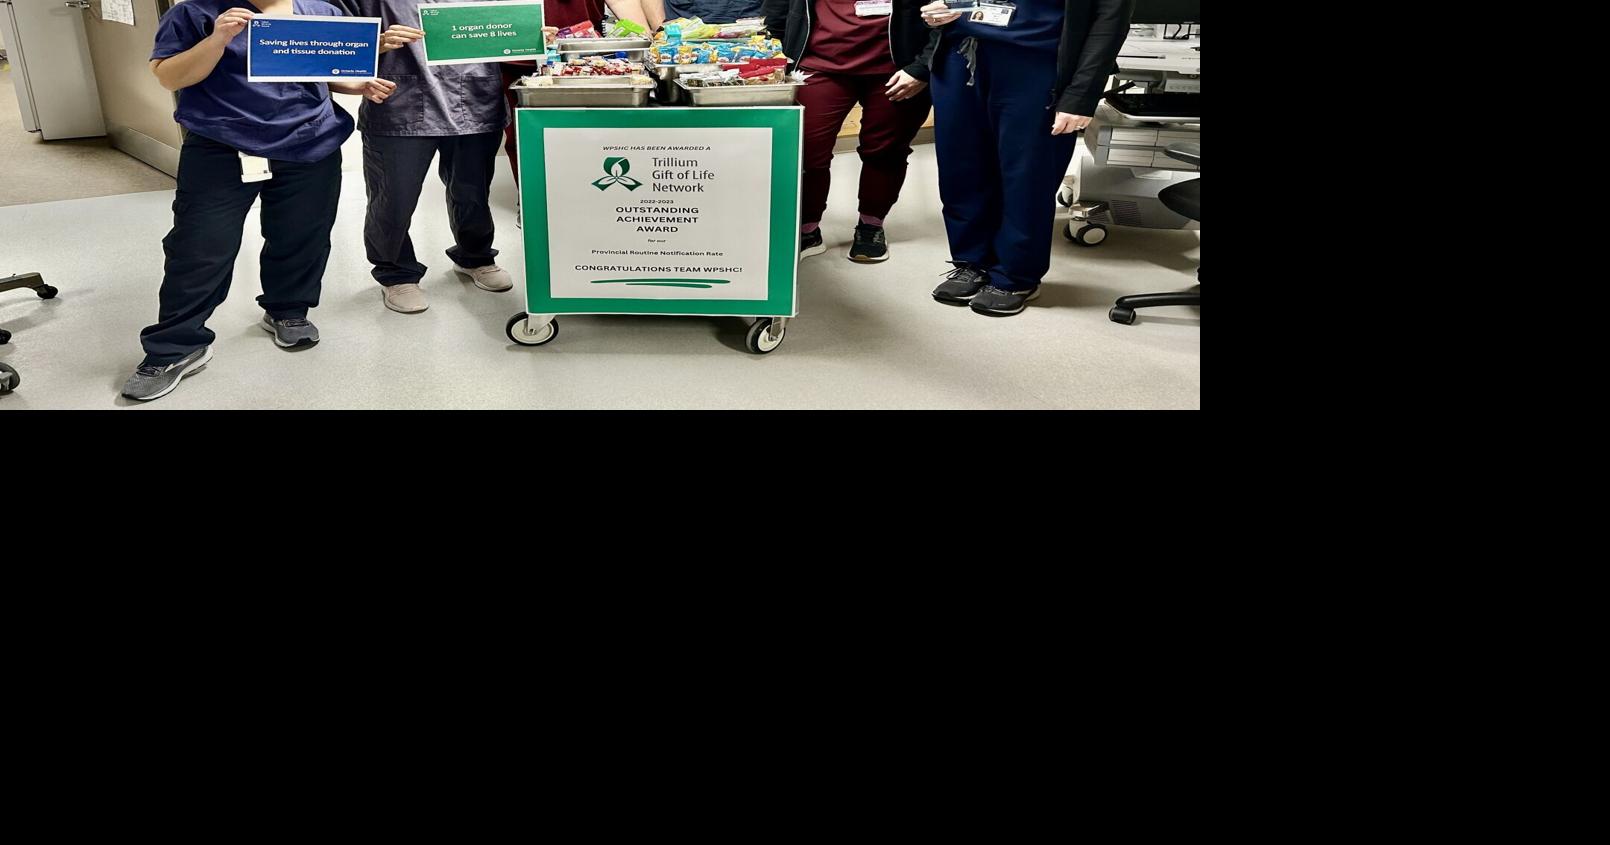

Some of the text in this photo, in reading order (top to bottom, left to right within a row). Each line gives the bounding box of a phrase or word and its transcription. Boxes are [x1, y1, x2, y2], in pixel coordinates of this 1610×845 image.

[652, 158, 698, 167] Trillium
[652, 170, 715, 180] Gift of Life
[652, 183, 704, 192] Network
